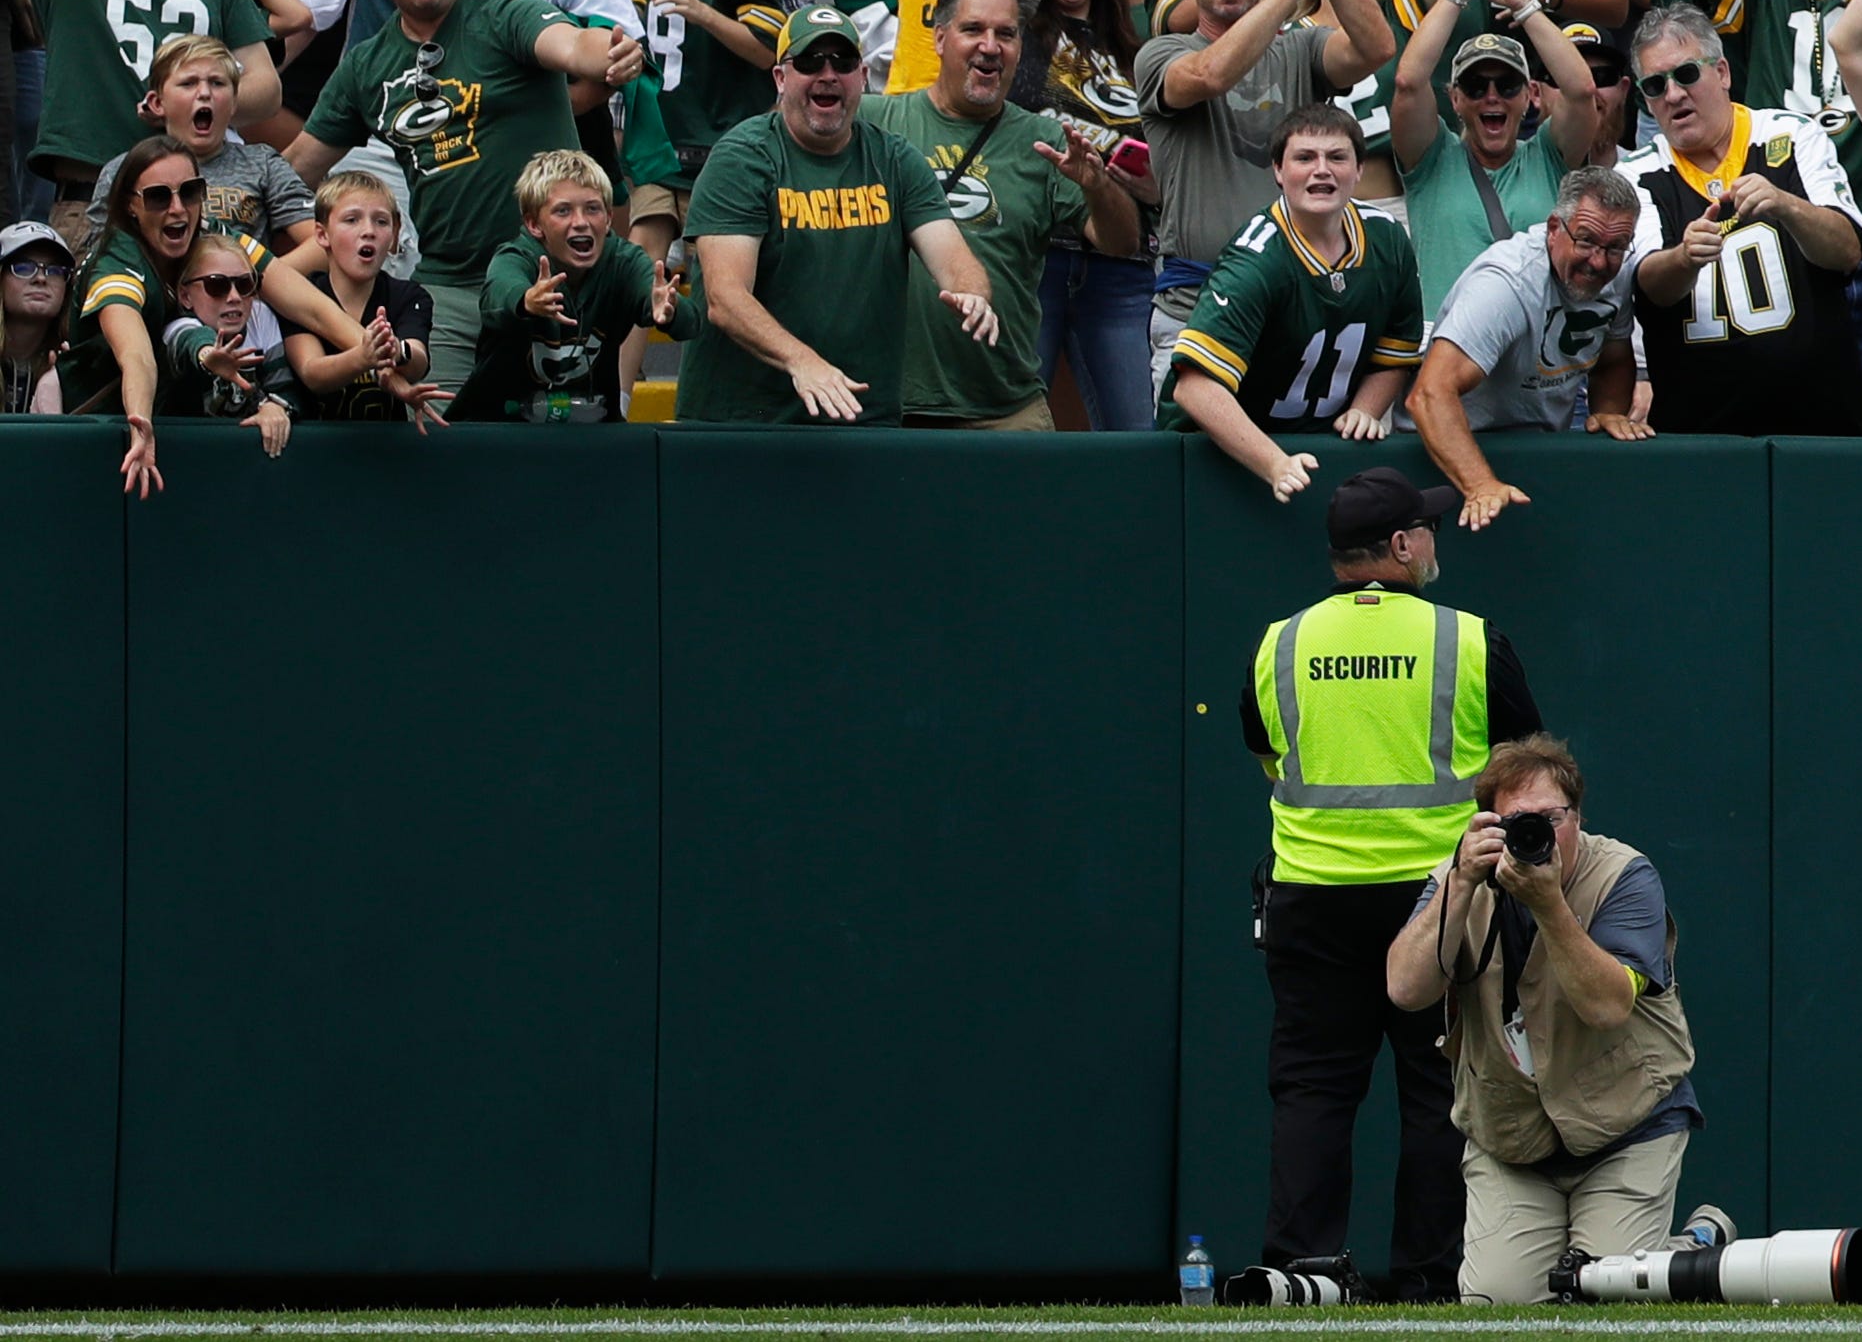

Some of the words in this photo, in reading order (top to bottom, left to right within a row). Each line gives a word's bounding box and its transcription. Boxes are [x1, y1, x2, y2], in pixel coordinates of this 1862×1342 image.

[808, 8, 844, 27] G
[395, 97, 453, 135] G
[1815, 108, 1849, 135] G
[434, 137, 463, 154] PACK
[778, 183, 892, 231] PACKERS
[1683, 220, 1796, 343] 10
[1268, 322, 1367, 420] 11
[1309, 655, 1418, 681] SECURITY
